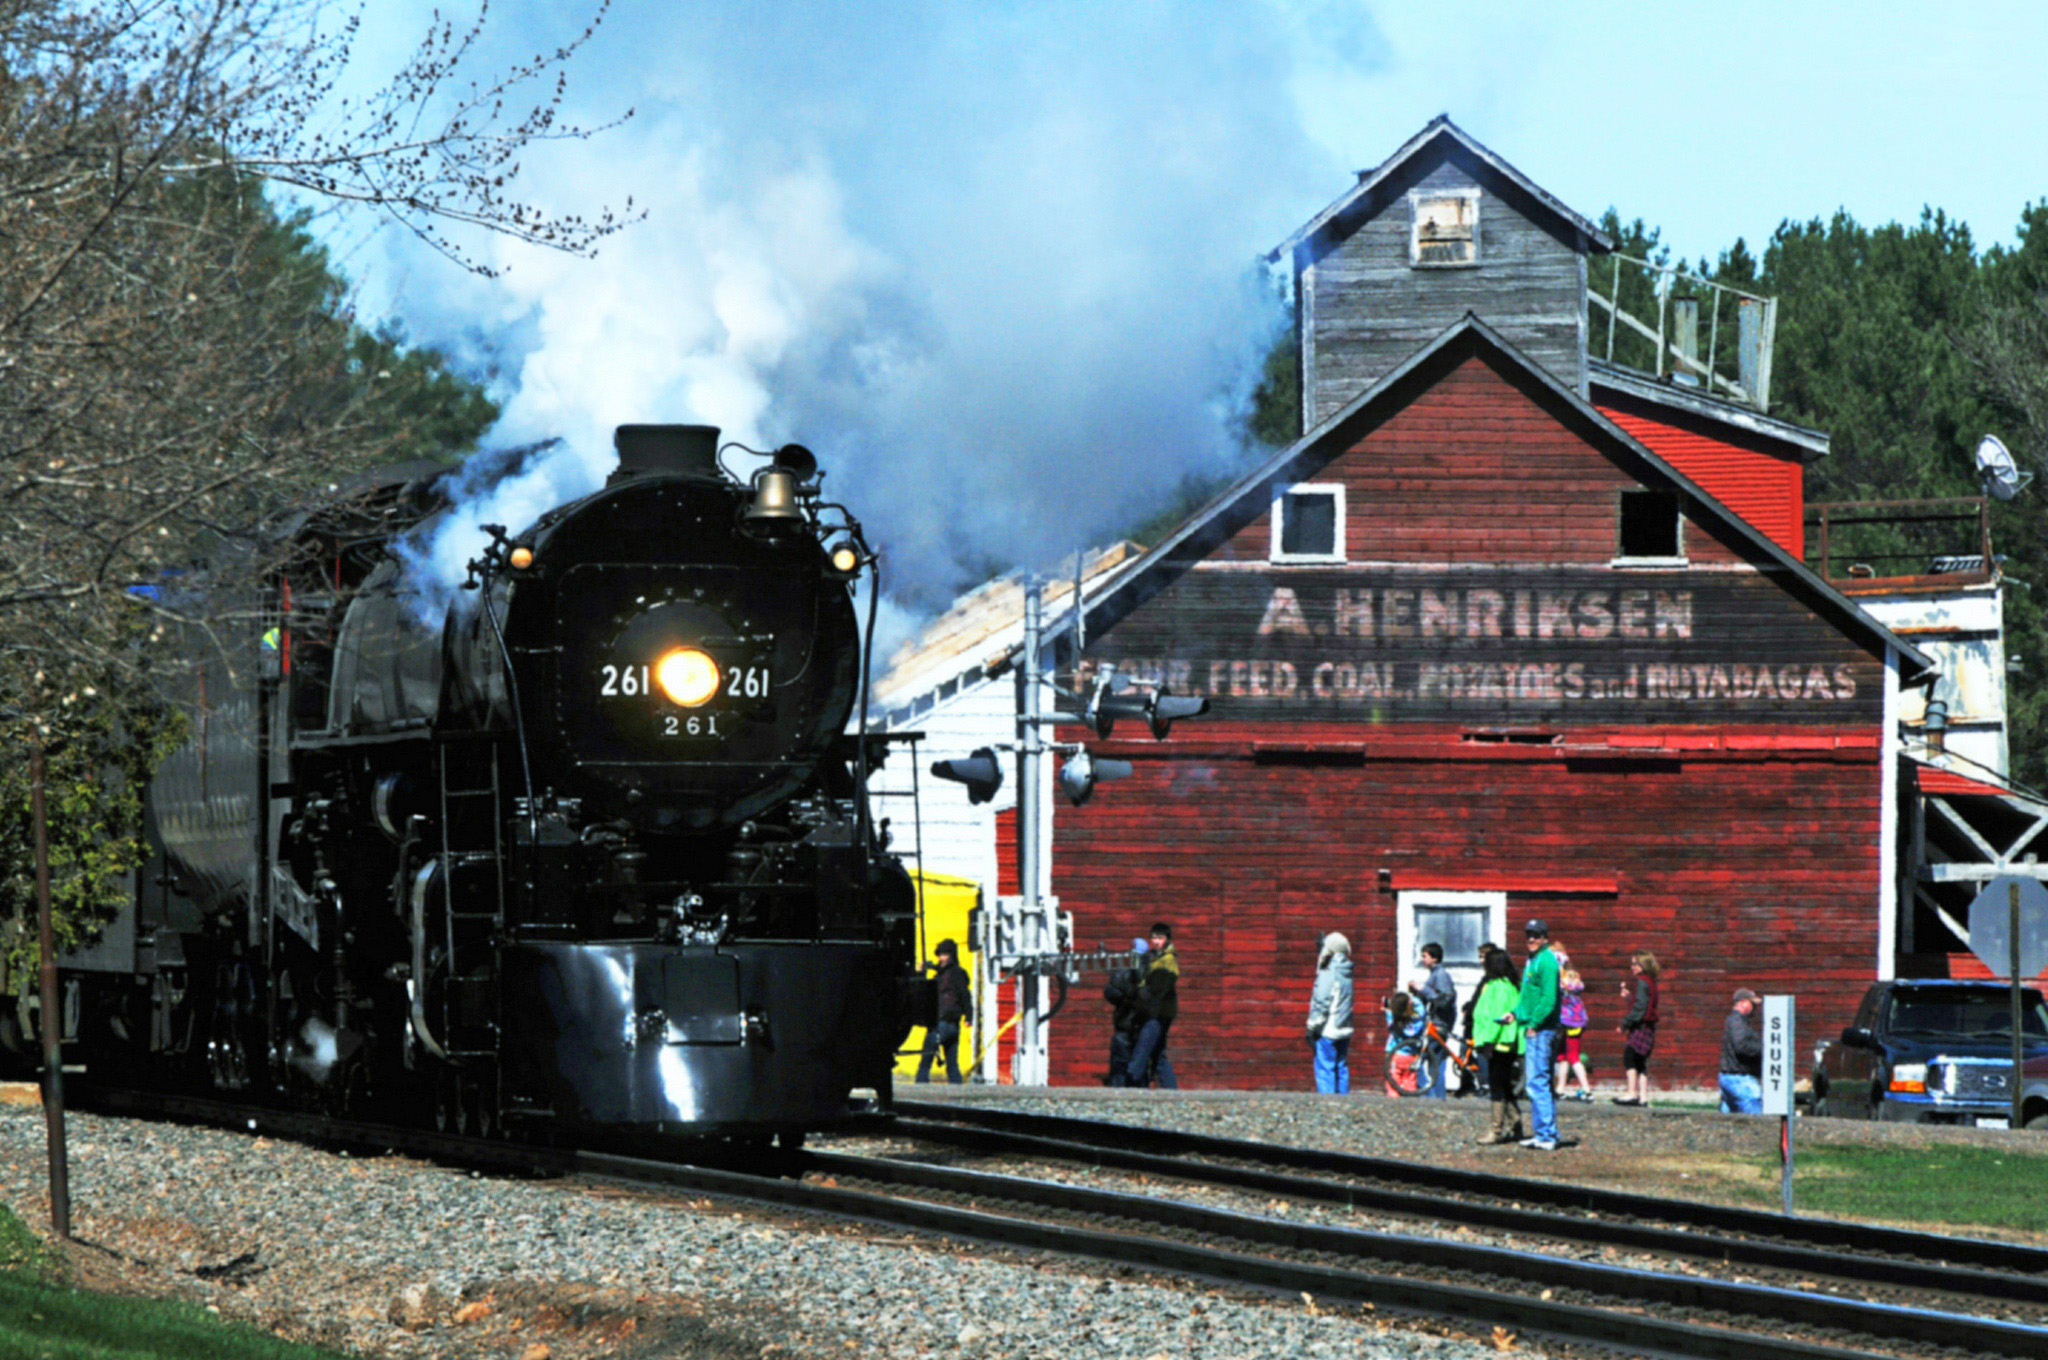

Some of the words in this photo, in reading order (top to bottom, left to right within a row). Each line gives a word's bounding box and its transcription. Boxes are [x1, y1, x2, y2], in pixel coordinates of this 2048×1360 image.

[1335, 588, 1693, 638] HENRIKSEN
[601, 664, 649, 696] 261
[727, 666, 769, 698] 261
[1590, 662, 1638, 699] and
[1646, 663, 1856, 700] RUTABAGAS
[664, 716, 717, 735] 261
[1770, 1016, 1782, 1091] SHUNT
